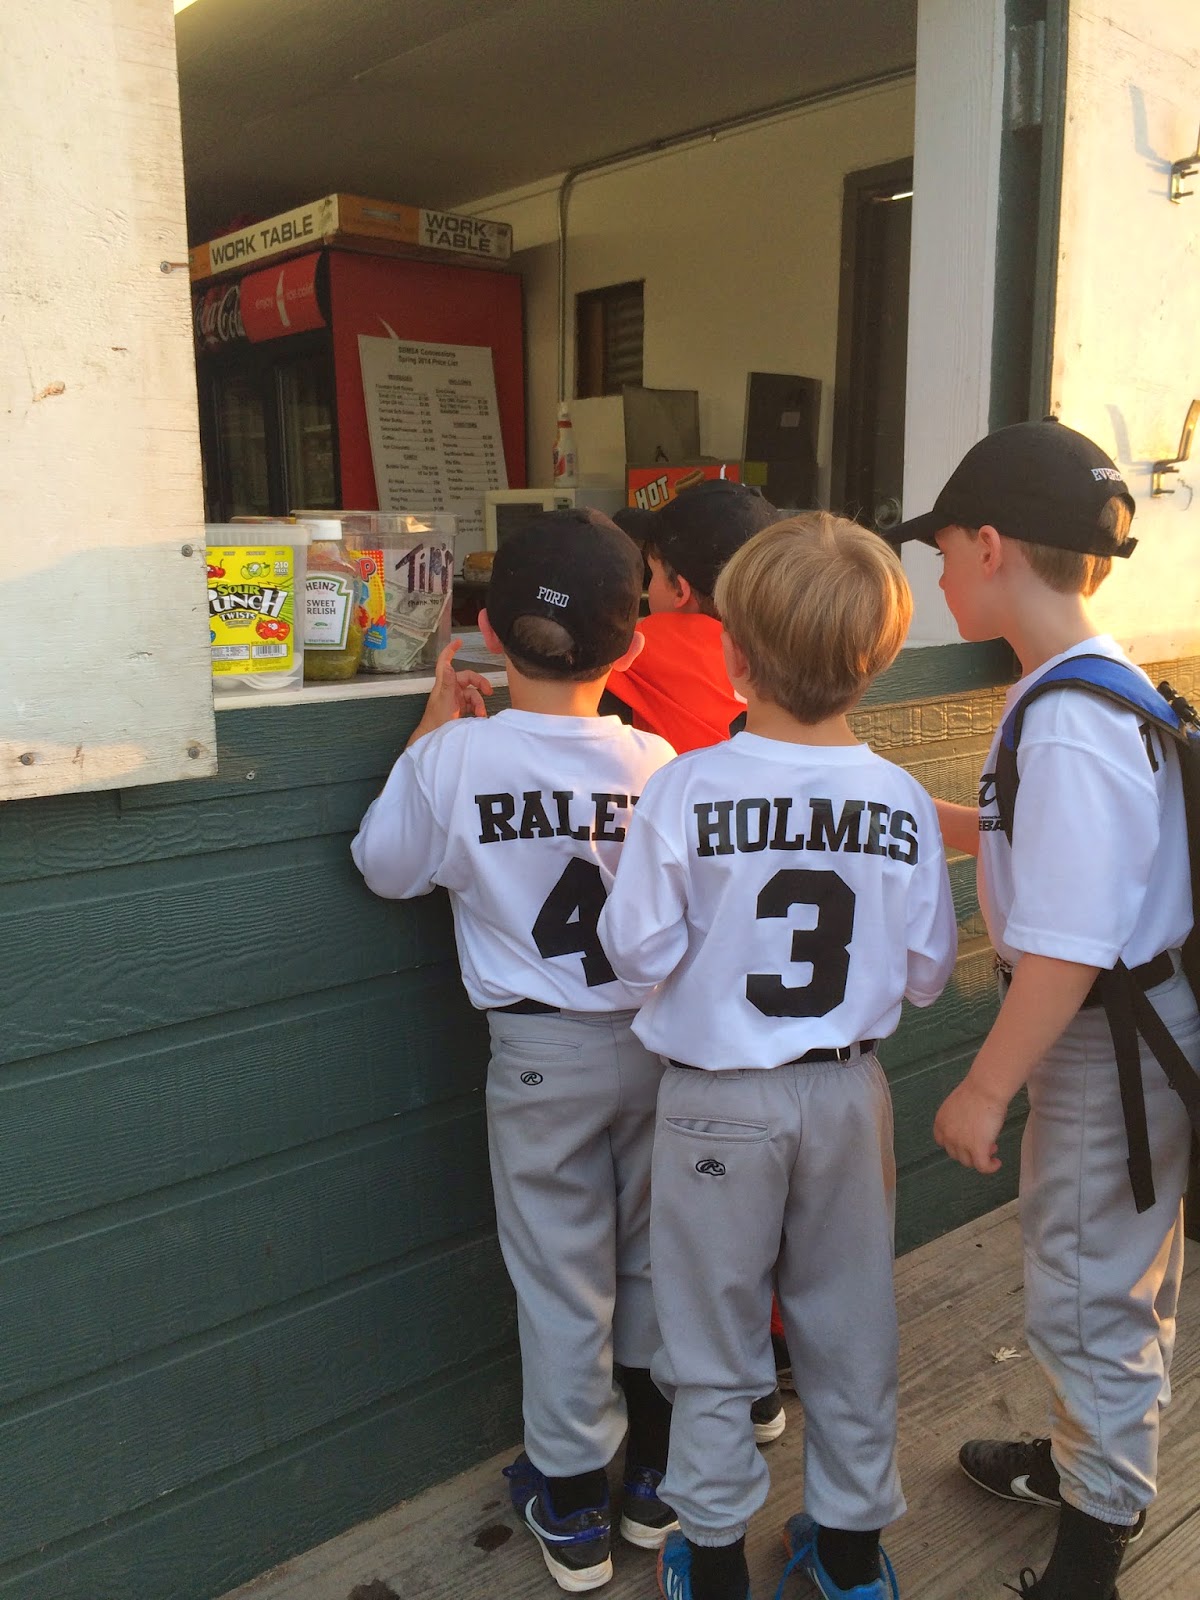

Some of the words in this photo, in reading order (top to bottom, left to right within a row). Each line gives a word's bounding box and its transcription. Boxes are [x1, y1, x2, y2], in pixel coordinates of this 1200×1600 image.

[425, 212, 487, 238] WORK
[212, 233, 257, 266] WORK
[260, 214, 314, 249] TABLE
[425, 228, 491, 253] TABLE
[635, 476, 669, 510] HOT
[274, 561, 289, 569] 210
[216, 584, 260, 597] SOUR
[305, 581, 337, 592] HEINZ
[536, 585, 570, 608] FORD
[219, 610, 257, 621] TWISTS
[306, 599, 336, 607] SWEET
[306, 607, 336, 615] RELISH
[474, 790, 640, 844] RALE
[693, 797, 919, 866] HOLMES
[531, 856, 619, 987] 4
[745, 868, 857, 1018] 3
